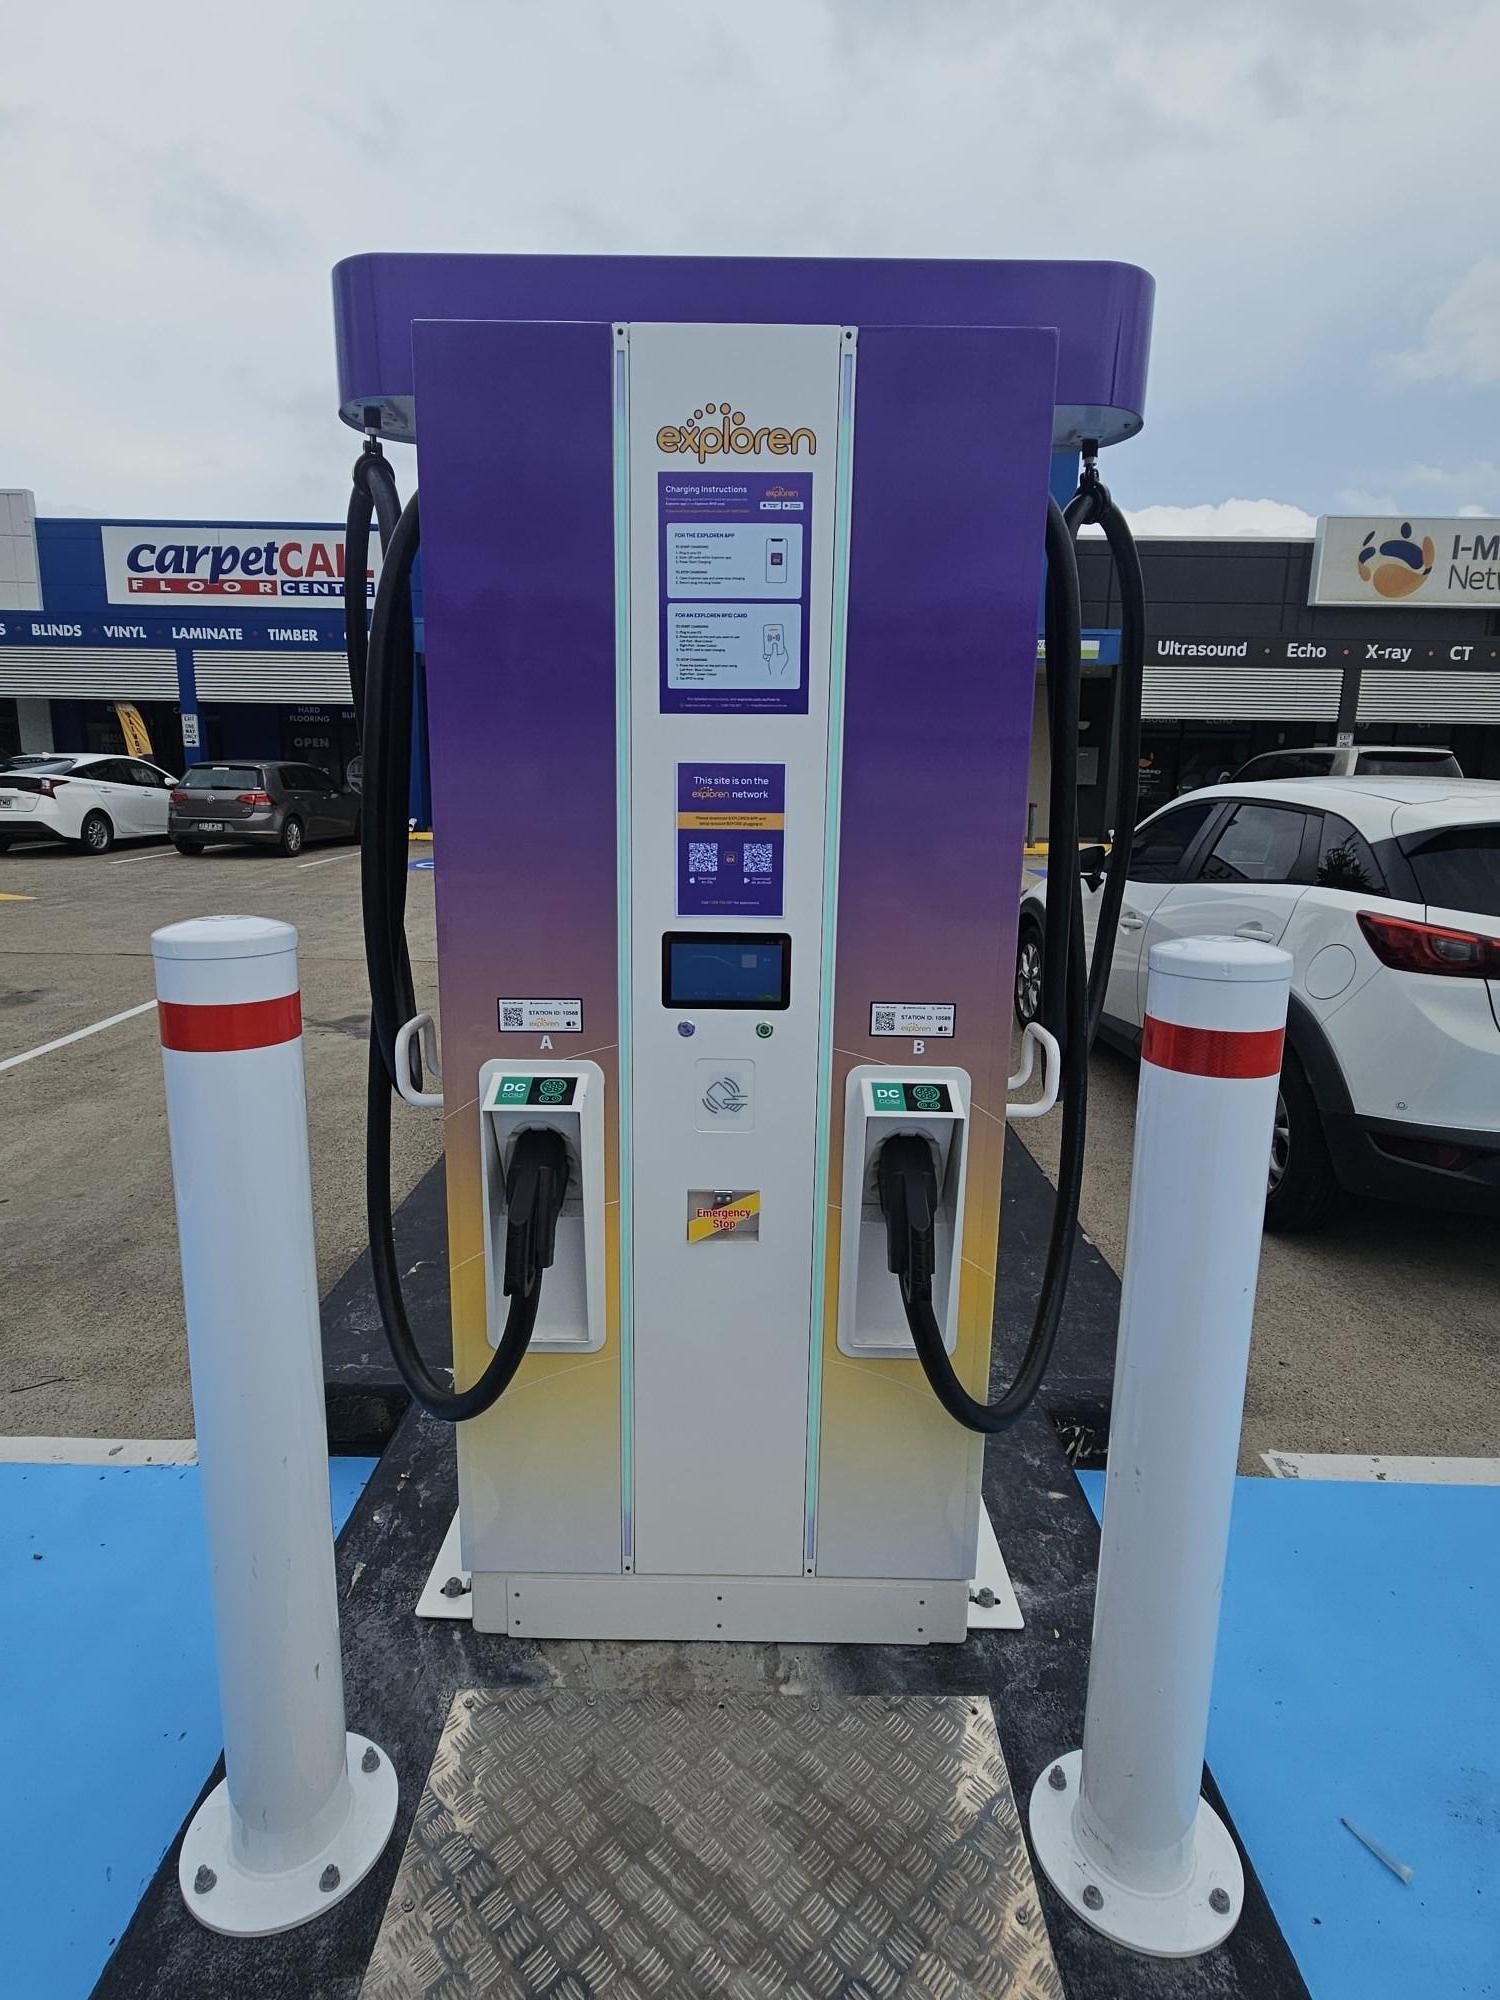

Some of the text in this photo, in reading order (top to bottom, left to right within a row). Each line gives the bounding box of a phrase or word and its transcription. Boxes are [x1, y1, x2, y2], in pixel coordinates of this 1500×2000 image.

[656, 403, 817, 464] exploren
[665, 485, 748, 495] Charging Instructions
[765, 486, 799, 498] exploren
[126, 540, 374, 585] carpetCAL
[1448, 564, 1500, 590] Net
[130, 579, 274, 594] FLOOR
[282, 583, 373, 595] CENTE
[31, 624, 319, 642] BLINDS VINYL LAMINATE TIMBER
[1157, 640, 1475, 663] Ultrasound Echo X-ray CT
[294, 737, 329, 748] OPEN
[694, 776, 713, 785] This
[714, 776, 731, 785] site
[732, 776, 740, 785] is
[754, 777, 769, 785] the
[692, 787, 769, 800] exploren network
[540, 1035, 553, 1050] A
[913, 1040, 925, 1054] B
[503, 1083, 526, 1092] DC
[876, 1089, 900, 1098] DC
[697, 1208, 751, 1219] Emergency
[713, 1219, 736, 1230] Stop
